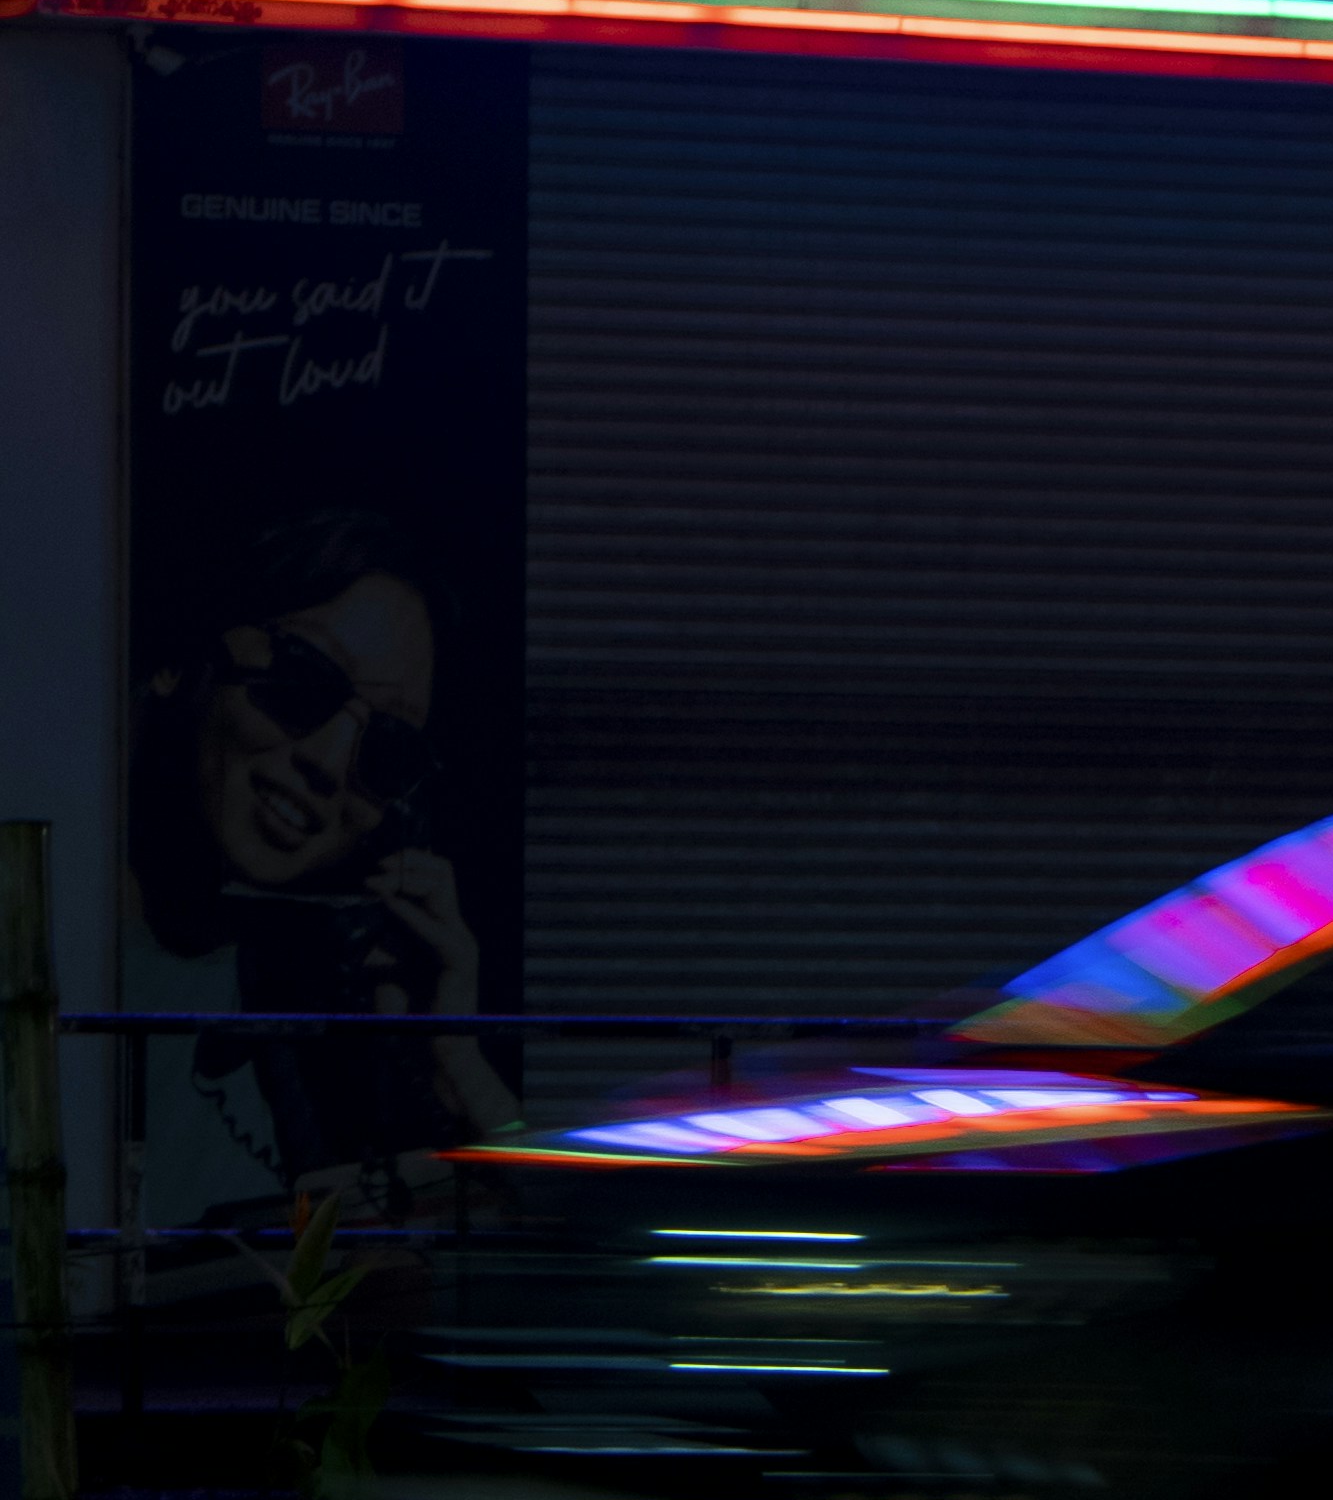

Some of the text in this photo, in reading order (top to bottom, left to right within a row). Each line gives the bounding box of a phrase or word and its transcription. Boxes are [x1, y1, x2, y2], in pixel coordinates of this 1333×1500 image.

[267, 49, 396, 122] Ray-Ban
[179, 192, 424, 229] GENUINE SINCE
[171, 238, 495, 352] you said it
[162, 322, 389, 416] out loud
